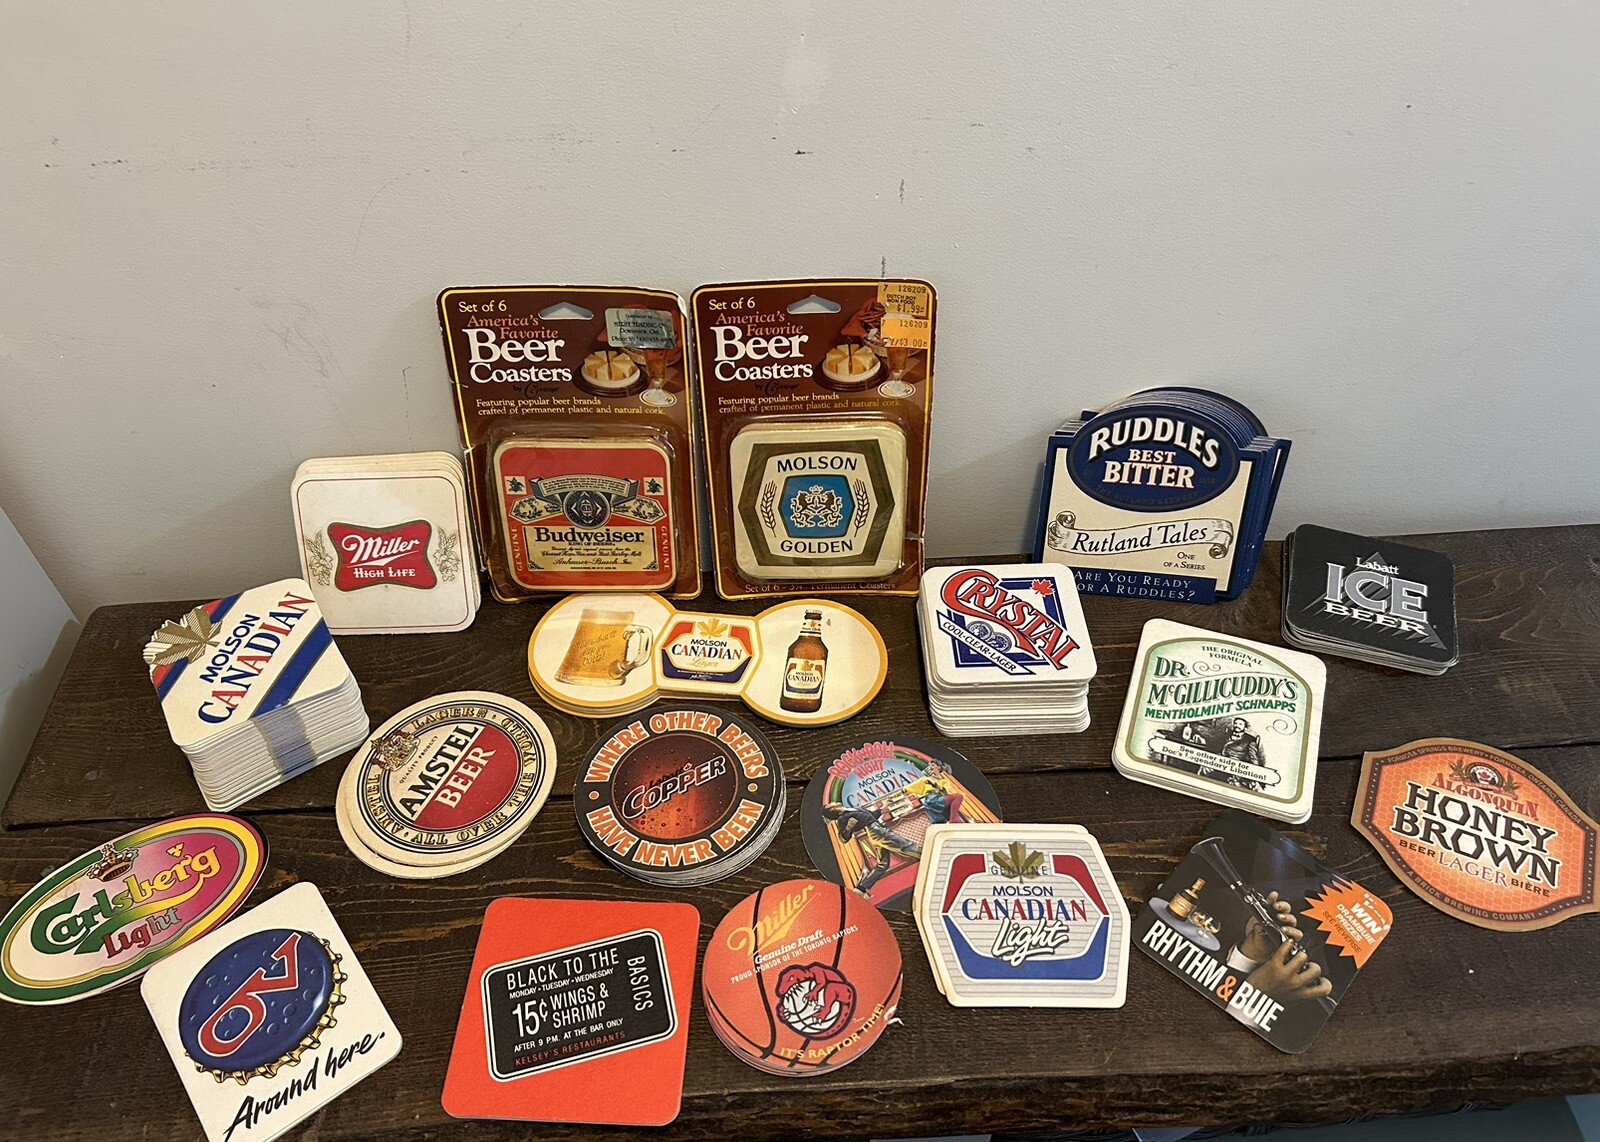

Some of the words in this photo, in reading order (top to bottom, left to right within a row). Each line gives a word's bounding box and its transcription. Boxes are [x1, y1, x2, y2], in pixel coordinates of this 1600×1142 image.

[709, 299, 728, 310] Set
[731, 298, 744, 310] of
[747, 297, 755, 308] 6
[898, 285, 927, 293] 126209
[458, 301, 478, 313] Set
[481, 300, 494, 312] of
[498, 300, 507, 311] 6
[467, 314, 539, 327] America's
[715, 310, 785, 324] America's
[500, 326, 559, 339] Favorite
[746, 324, 803, 336] Favorite
[900, 320, 928, 328] 126209
[461, 328, 565, 363] Beer
[710, 326, 809, 361] Beer
[470, 362, 573, 383] Coasters
[715, 361, 813, 381] Coasters
[476, 399, 515, 408] Featuring
[518, 398, 550, 407] popular
[573, 397, 601, 405] brands
[478, 407, 506, 416] crafted
[522, 407, 565, 416] permanent
[569, 406, 593, 416] plastic
[596, 406, 611, 414] and
[614, 406, 643, 414] natural
[718, 397, 755, 406] Featuring
[758, 395, 788, 404] popular
[812, 392, 839, 400] brands
[719, 404, 746, 413] crafted
[761, 403, 803, 413] permanent
[806, 401, 831, 411] plastic
[833, 400, 848, 408] and
[852, 399, 879, 408] natural
[1088, 416, 1220, 469] RUDDLES
[1128, 449, 1176, 464] BEST
[777, 456, 858, 473] MOLSON
[1102, 460, 1195, 489] BITTER
[341, 534, 420, 563] Miller
[511, 525, 523, 572] GENUINE
[661, 525, 671, 571] GENUINE
[780, 540, 853, 554] GOLDEN
[1071, 527, 1151, 553] Rutland
[1157, 523, 1207, 544] Tales
[1177, 552, 1195, 560] ONE
[1180, 561, 1205, 570] SERIES
[1356, 557, 1399, 575] Labatt
[745, 584, 759, 593] Set
[1074, 571, 1101, 581] ARE
[1108, 572, 1137, 584] YOU
[1143, 576, 1191, 589] READY
[1076, 583, 1094, 592] OR
[1116, 585, 1196, 601] RUDDLES?
[1324, 562, 1428, 624] ICE
[940, 568, 1080, 670] CRYSTAL
[1324, 601, 1429, 636] BEER
[198, 592, 316, 724] CANADIAN
[199, 613, 261, 683] MOLSON
[671, 644, 742, 660] CANADIAN
[690, 639, 727, 648] MOLSON
[1209, 652, 1252, 668] FORMULA
[1221, 648, 1263, 666] ORIGINAL
[1153, 656, 1190, 678] DR.
[1144, 702, 1234, 720] MENTHOLMINT
[1235, 699, 1296, 713] SCHNAPPS
[399, 760, 419, 784] QUALITY
[418, 735, 438, 759] PRODUCT
[584, 720, 650, 783] WHERE
[650, 710, 723, 738] OTHER
[717, 723, 769, 780] BEERS
[1162, 746, 1182, 756] Doc's
[1230, 766, 1267, 780] Libation!
[1180, 746, 1194, 754] See
[1196, 750, 1217, 761] other
[1219, 757, 1236, 767] side
[399, 725, 479, 817] AMSTEL
[411, 833, 448, 845] ALL
[456, 811, 508, 842] OVER
[501, 717, 537, 768] WORLD
[434, 746, 497, 809] BEER
[854, 758, 884, 778] NIGHT
[858, 768, 896, 788] MOLSON
[622, 755, 726, 819] COPPER
[847, 768, 919, 808] CANADIAN
[1388, 751, 1419, 763] FORMOSA
[1448, 746, 1484, 757] BREWERY
[1556, 799, 1581, 824] CANADA
[1431, 772, 1539, 822] ALGONQUIN
[586, 804, 640, 857] HAVE
[632, 838, 718, 867] NEVER
[710, 798, 766, 852] BEEN
[1404, 782, 1556, 854] HONEY
[1391, 807, 1562, 887] BROWN
[990, 865, 1048, 876] GENUINE
[1399, 839, 1436, 858] BEER
[1438, 850, 1510, 888] LAGER
[1511, 878, 1550, 897] BIÈRE
[30, 845, 222, 955] Carlsberg
[992, 885, 1053, 897] MOLSON
[1415, 877, 1441, 898] BRICK
[1444, 896, 1489, 918] BREWING
[1492, 911, 1536, 922] COMPANY
[726, 884, 815, 957] Miller
[961, 898, 1087, 922] CANADIAN
[1336, 903, 1376, 945] DRAMBUIE
[1350, 902, 1383, 935] WIN
[103, 906, 183, 959] Light
[991, 917, 1069, 967] Light
[1322, 910, 1335, 924] SEE
[1334, 922, 1362, 953] REVERSE
[1335, 913, 1363, 942] PRIZES
[731, 970, 753, 984] PROUD
[753, 958, 782, 974] SPONSOR
[804, 937, 832, 952] TORONTO
[832, 924, 859, 940] RAPTORS
[755, 943, 797, 964] Genuine
[797, 929, 824, 948] Draft
[506, 962, 559, 990] BLACK
[563, 957, 583, 976] TO
[589, 948, 620, 970] THE
[509, 986, 537, 999] MONDAY
[541, 978, 571, 992] TUESDAY
[574, 968, 614, 983] WEDNESDAY
[627, 955, 654, 1011] BASICS
[1142, 920, 1228, 992] RHYTHM
[1215, 975, 1237, 1002] &
[1229, 981, 1285, 1032] BUIE
[512, 999, 549, 1038] 15¢
[550, 986, 596, 1011] WINGS
[599, 982, 610, 999] &
[552, 1001, 606, 1029] SHRIMP
[514, 1041, 536, 1053] AFTER
[574, 1027, 588, 1037] THE
[590, 1022, 604, 1033] BAR
[606, 1018, 624, 1030] ONLY
[780, 1047, 805, 1059] IT'S
[808, 1032, 861, 1059] RAPTOR
[860, 1003, 885, 1033] TIME!
[515, 1048, 559, 1066] KELSEY'S
[562, 1031, 626, 1053] RESTAURANTS
[223, 1057, 319, 1142] Around
[325, 1031, 385, 1078] here.
